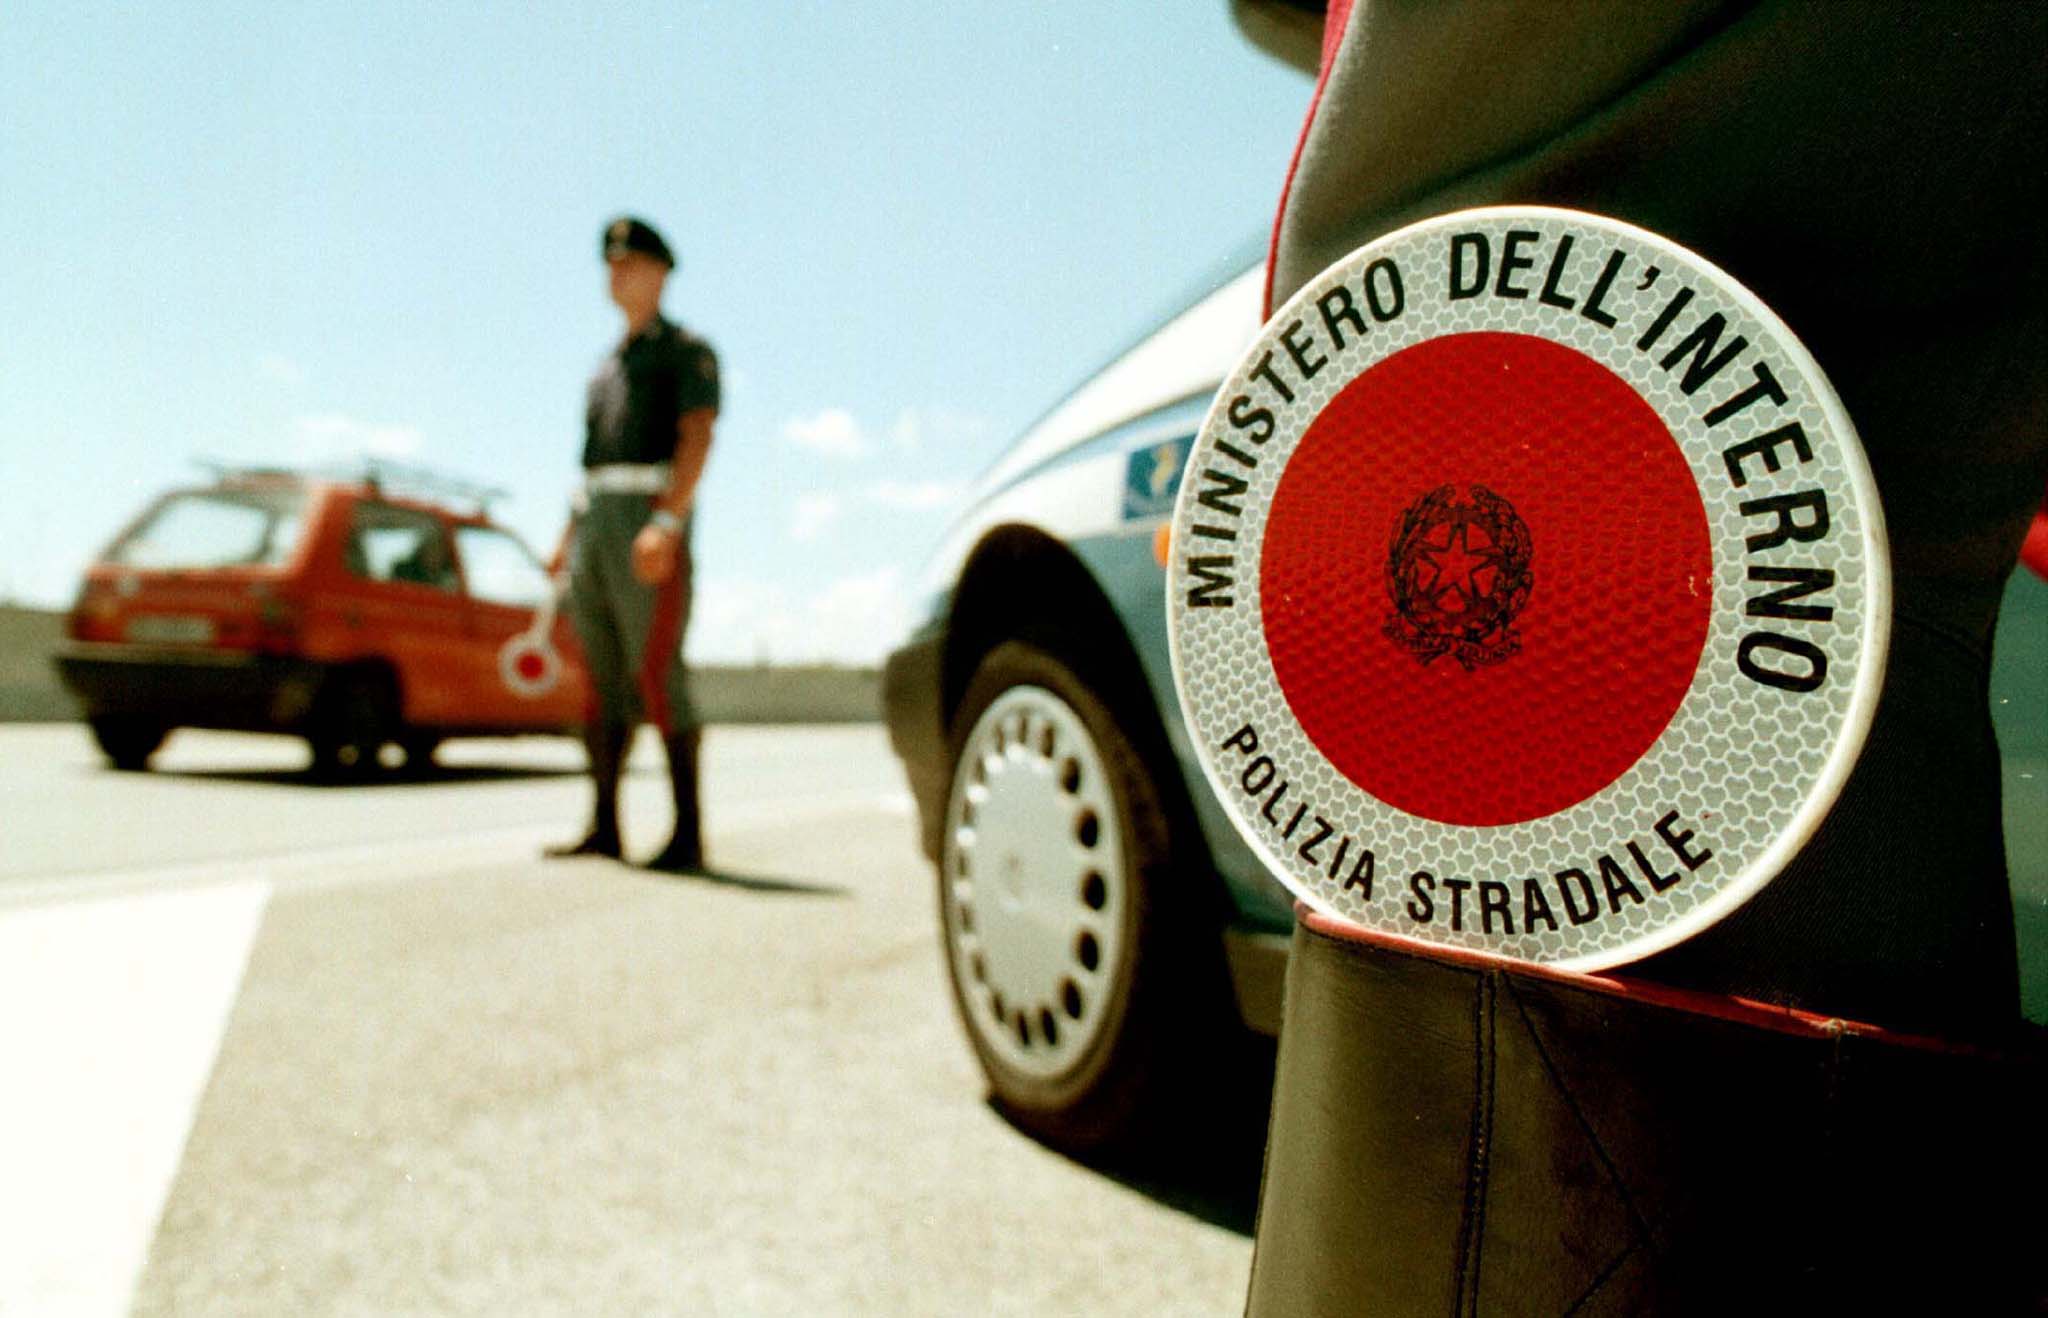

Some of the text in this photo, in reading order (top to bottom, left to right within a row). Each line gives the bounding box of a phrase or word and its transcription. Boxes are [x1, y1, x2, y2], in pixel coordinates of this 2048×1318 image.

[1187, 230, 1836, 694] MINISTERO DELL'INTERNO
[1221, 723, 1713, 936] POLIZIA STRADALE
